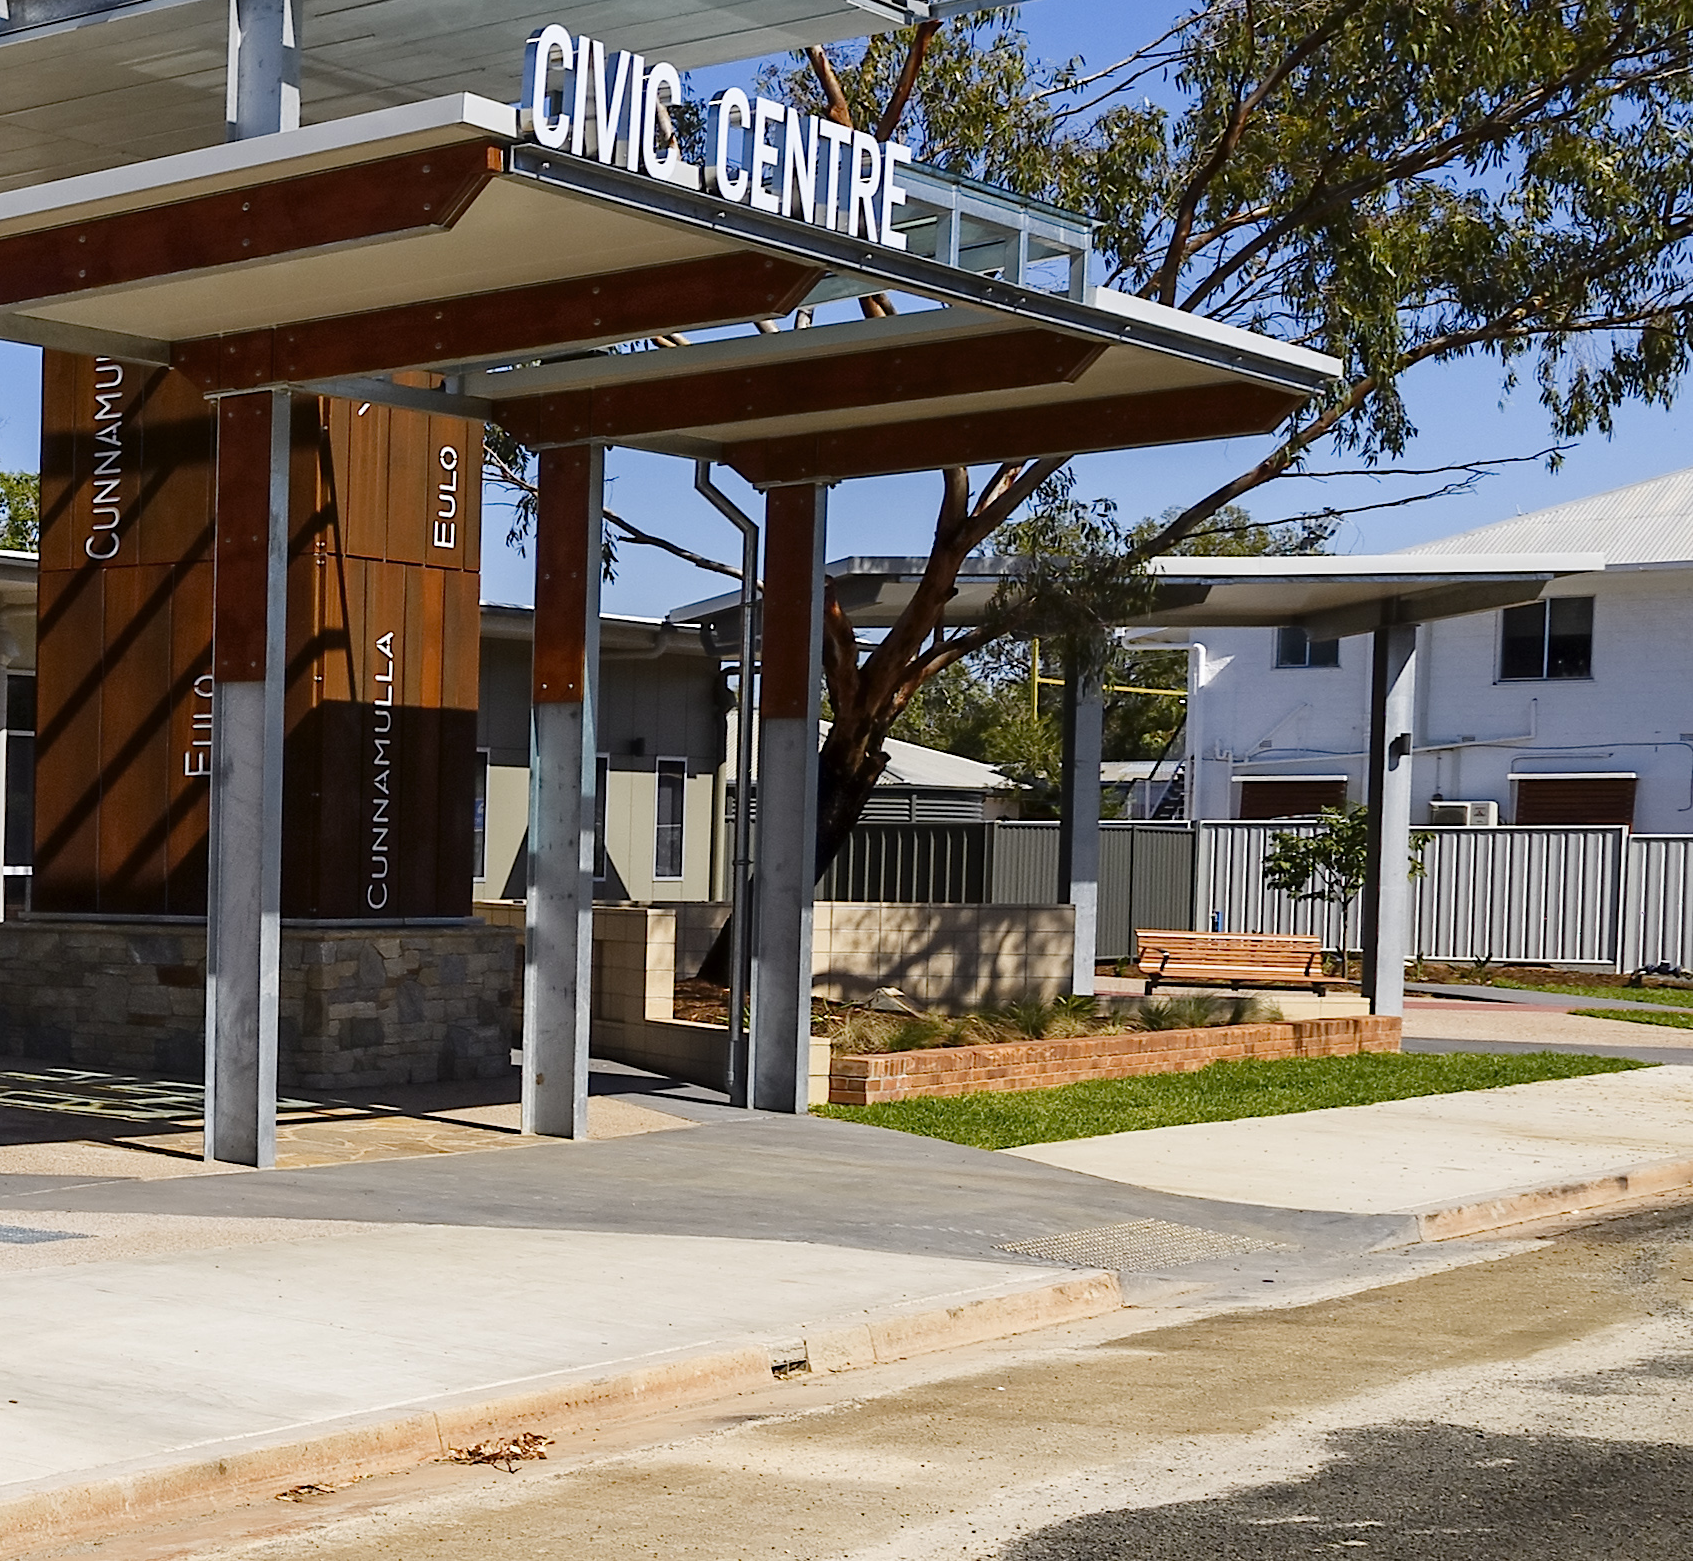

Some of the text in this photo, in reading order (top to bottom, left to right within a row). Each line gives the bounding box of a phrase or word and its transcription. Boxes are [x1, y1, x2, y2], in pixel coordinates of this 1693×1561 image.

[525, 23, 913, 251] CIVIC CENTRE
[432, 445, 459, 549] EULO
[367, 631, 395, 911] CUNNAMULLA
